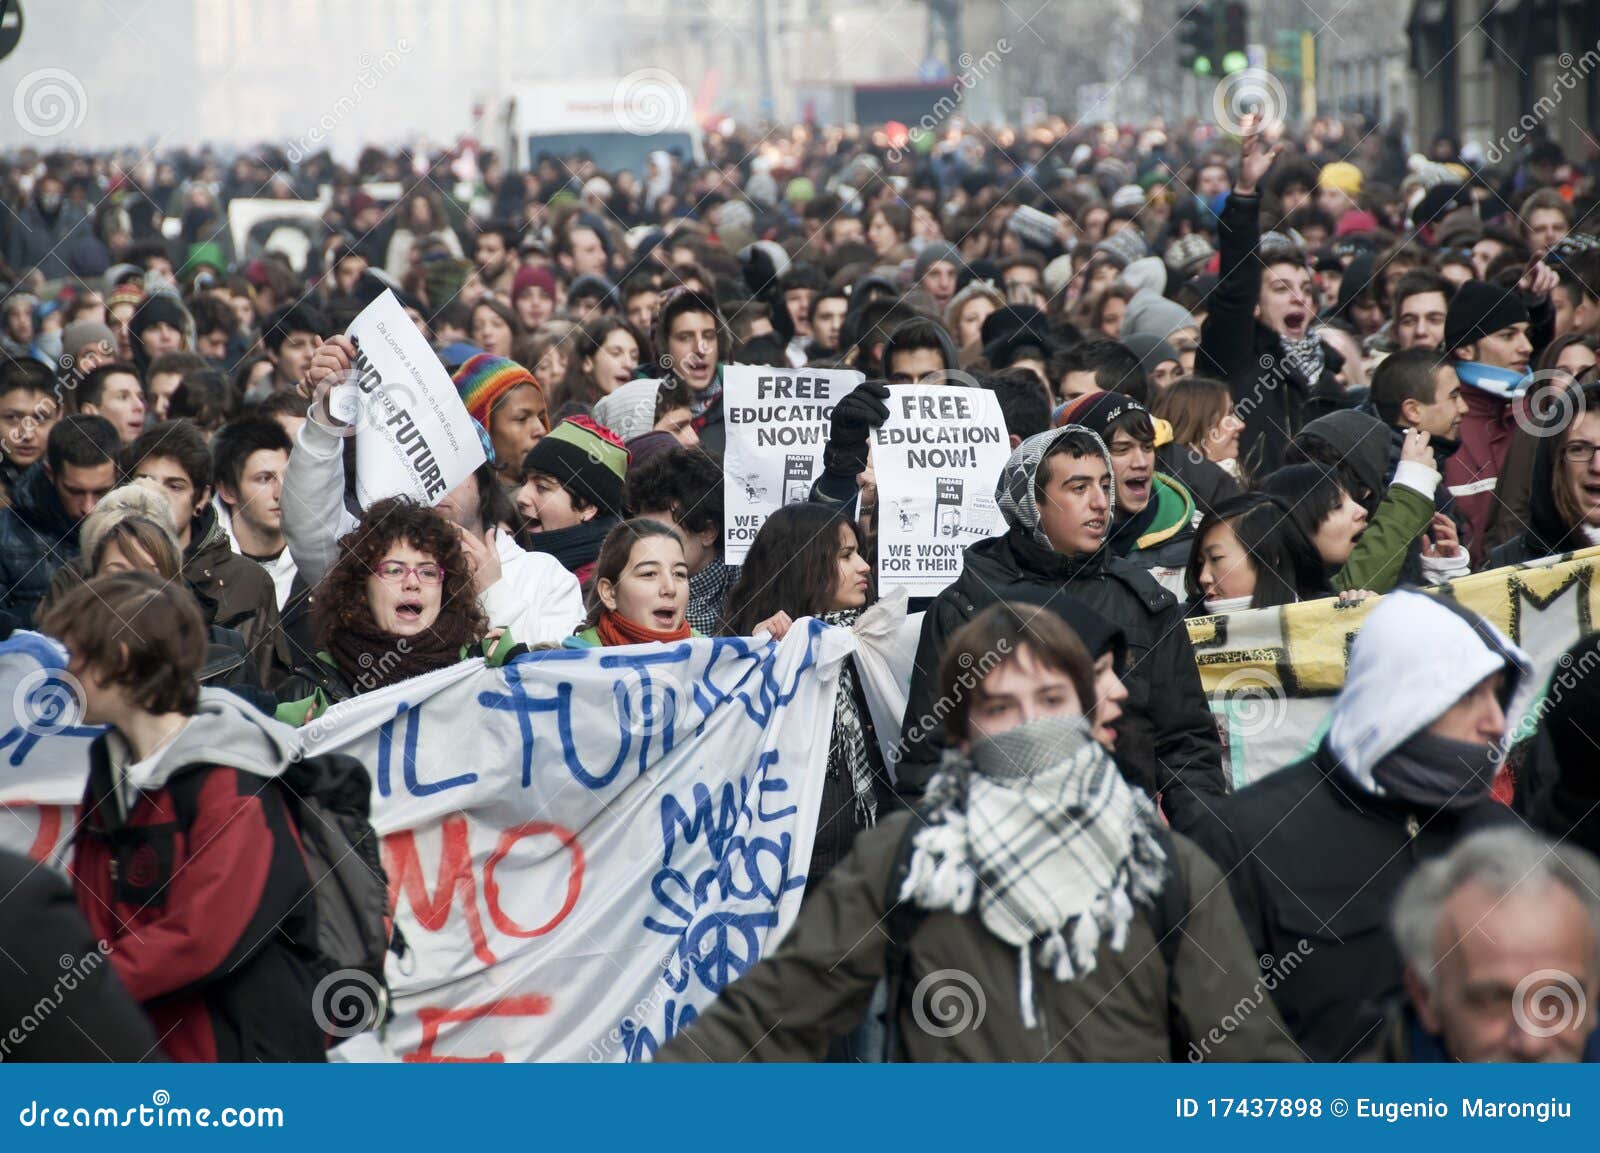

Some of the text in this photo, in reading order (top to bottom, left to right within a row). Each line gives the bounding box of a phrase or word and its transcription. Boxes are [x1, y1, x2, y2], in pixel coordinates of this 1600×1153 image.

[385, 330, 406, 360] Londra
[757, 376, 830, 400] FREE
[730, 405, 835, 423] EDUCATIO
[901, 395, 972, 420] FREE
[757, 423, 829, 447] NOW!
[876, 426, 1000, 445] EDUCATION
[386, 408, 448, 502] FUTURE
[907, 446, 977, 469] NOW!
[940, 492, 960, 500] RETTA
[734, 515, 759, 527] WE
[727, 528, 758, 540] FOR
[888, 544, 968, 557] WE WON'T
[881, 558, 958, 571] FOR THEIR
[377, 702, 479, 797] IL
